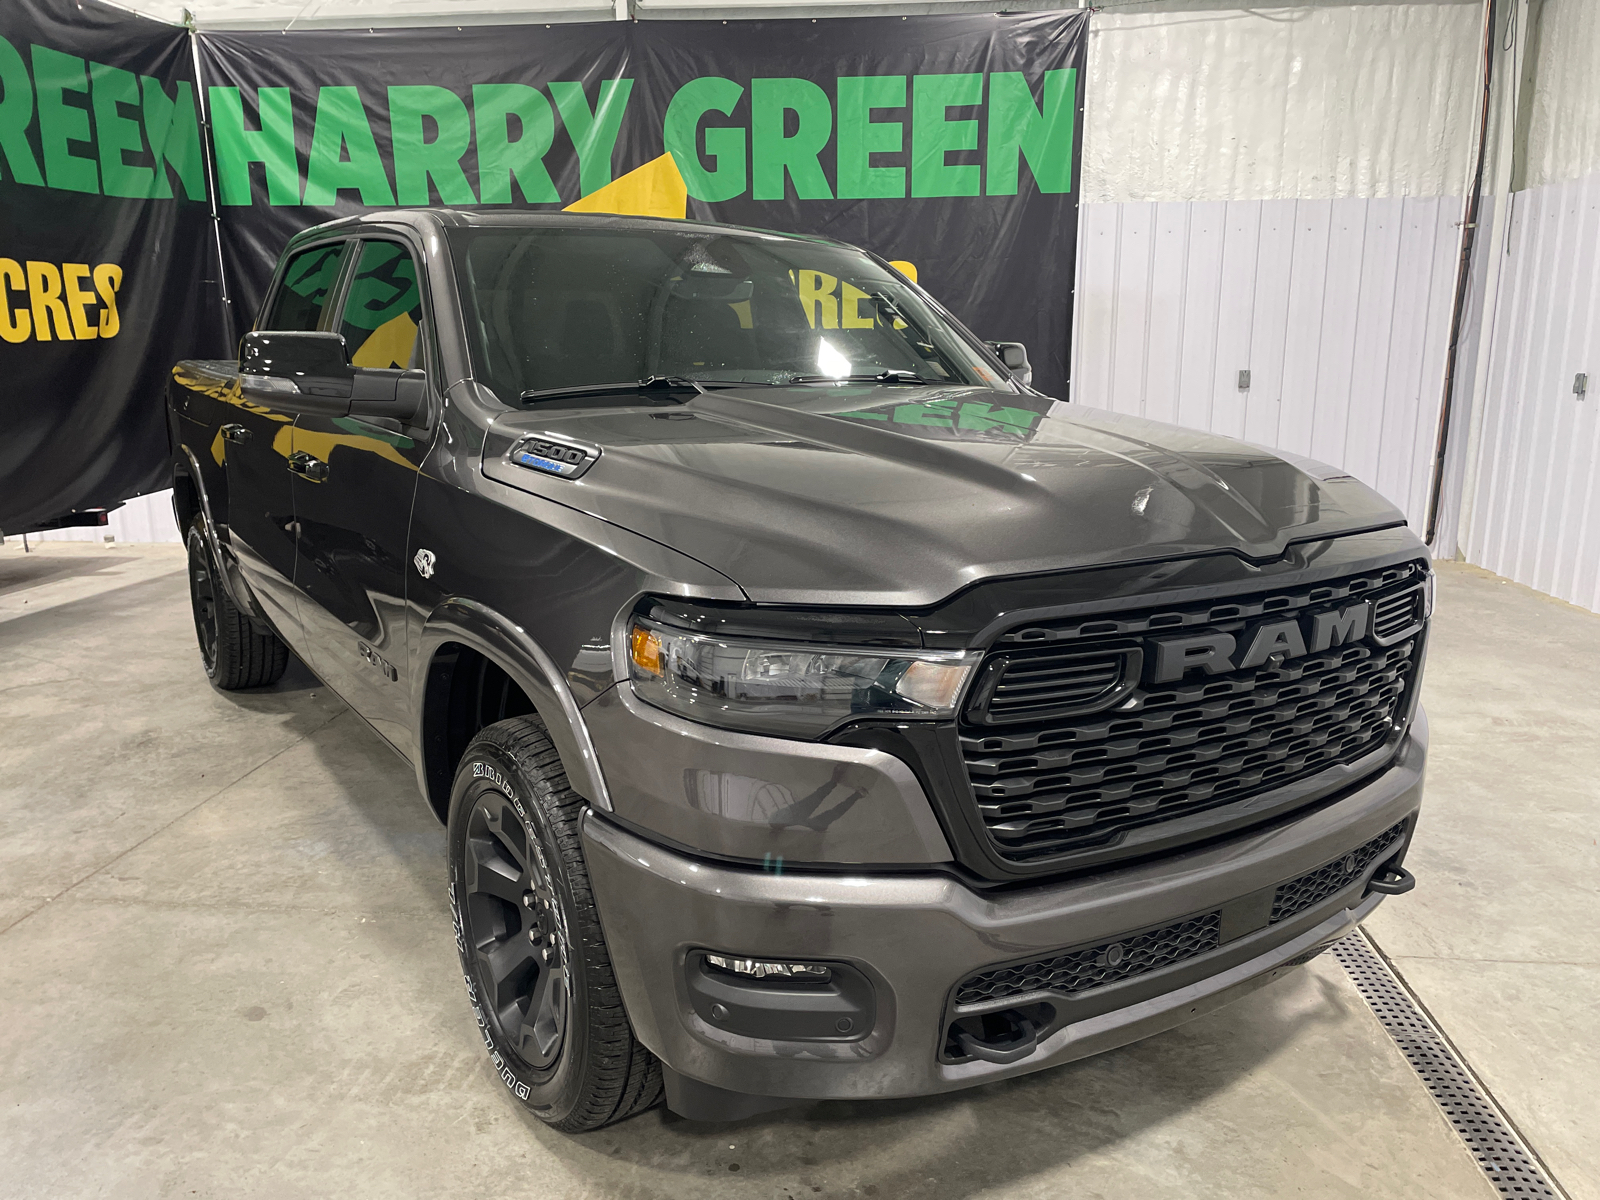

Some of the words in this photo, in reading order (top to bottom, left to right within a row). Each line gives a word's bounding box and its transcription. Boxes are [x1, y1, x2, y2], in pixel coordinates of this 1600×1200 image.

[209, 78, 635, 207] HARRY
[663, 68, 1077, 203] GREEN
[525, 440, 584, 465] 1500
[1148, 601, 1368, 684] RAM
